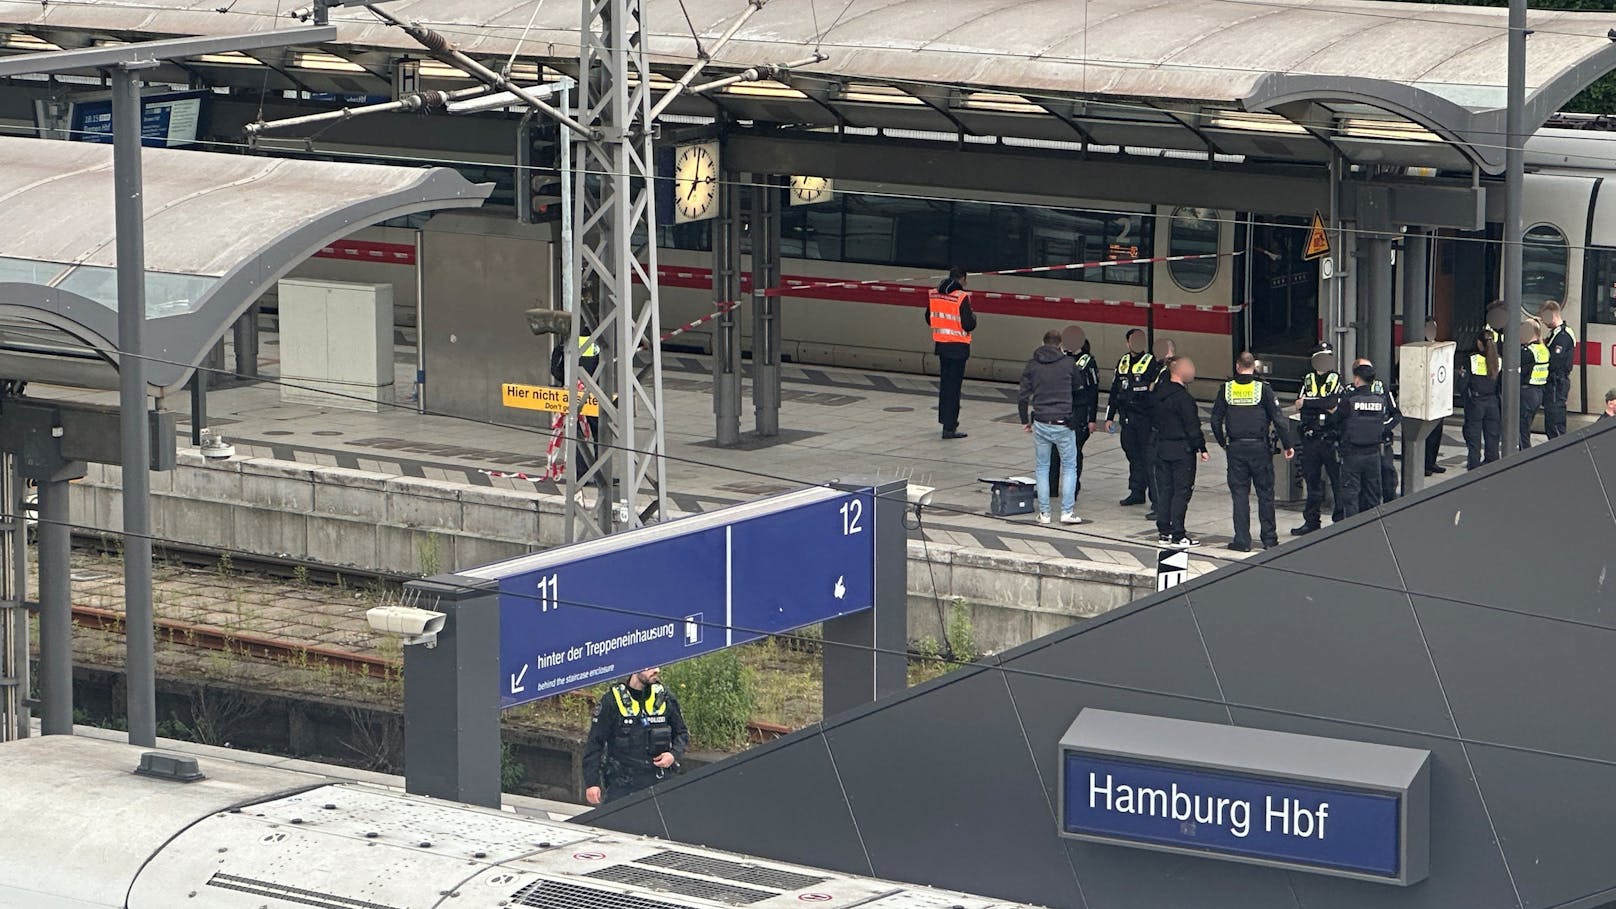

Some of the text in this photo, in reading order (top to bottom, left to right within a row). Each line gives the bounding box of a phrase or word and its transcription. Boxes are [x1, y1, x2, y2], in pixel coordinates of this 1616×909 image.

[1115, 217, 1131, 243] 2
[507, 385, 529, 398] Hier
[532, 388, 559, 402] nicht
[1354, 402, 1382, 411] POLIZEI
[839, 499, 863, 536] 12
[537, 573, 558, 612] 11
[537, 622, 675, 669] hinter der Treppeneinhausung
[537, 664, 615, 692] behind the staircase enclosure
[1089, 772, 1330, 840] Hamburg Hbf
